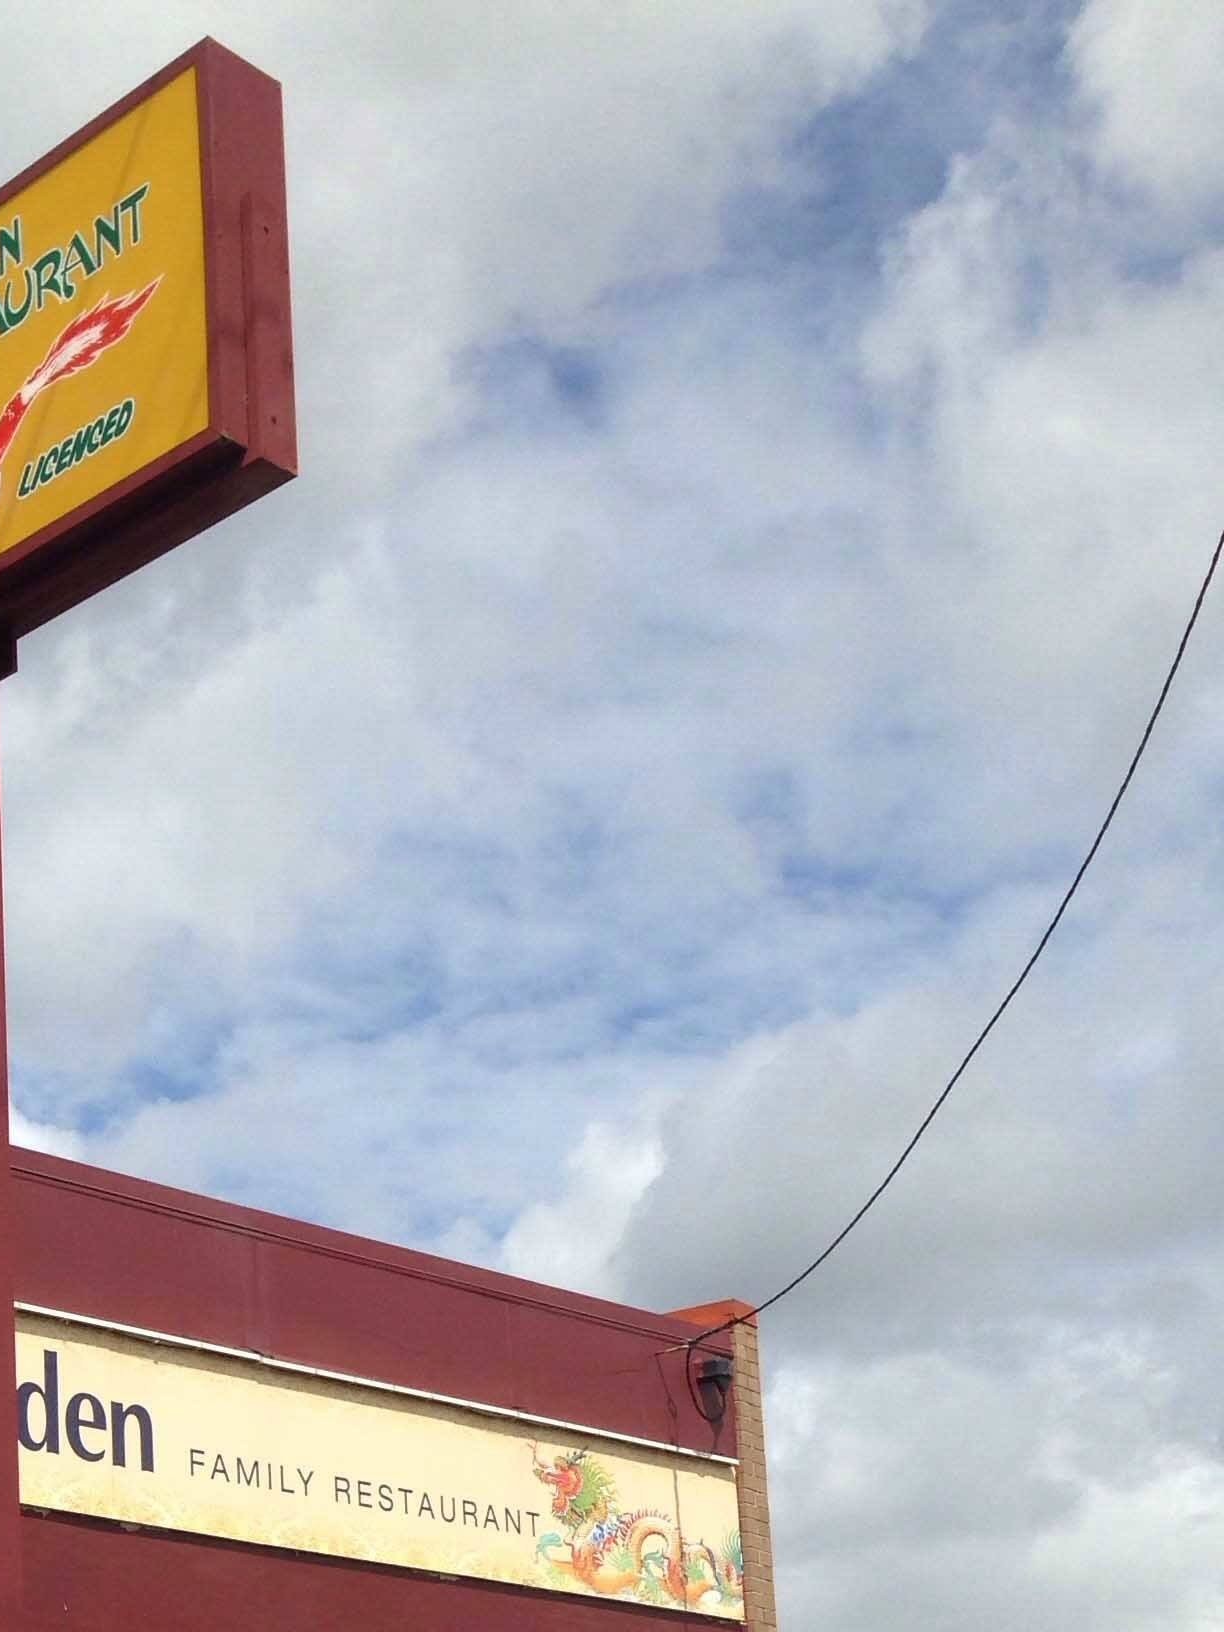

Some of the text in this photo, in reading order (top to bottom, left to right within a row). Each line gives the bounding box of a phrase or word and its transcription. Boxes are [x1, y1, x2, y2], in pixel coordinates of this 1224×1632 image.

[16, 398, 136, 499] LICENCED
[189, 1448, 315, 1498] FAMILY
[334, 1477, 541, 1538] RESTAURANT
